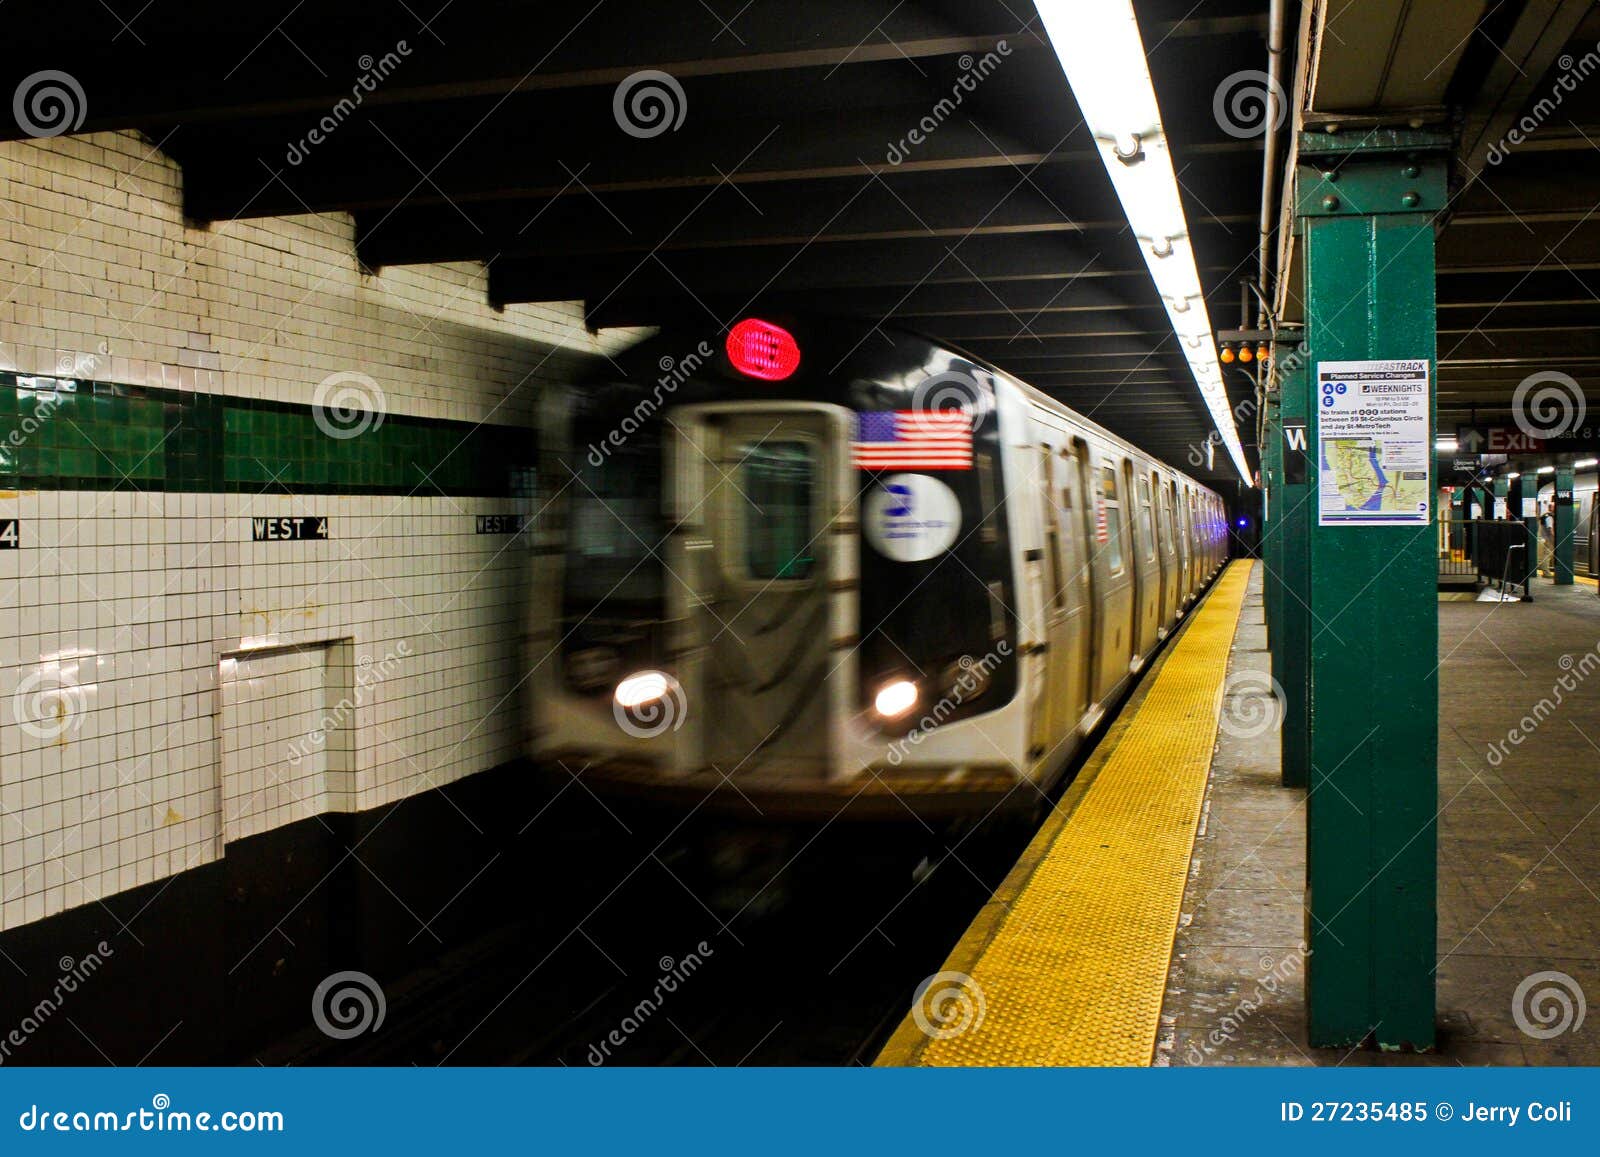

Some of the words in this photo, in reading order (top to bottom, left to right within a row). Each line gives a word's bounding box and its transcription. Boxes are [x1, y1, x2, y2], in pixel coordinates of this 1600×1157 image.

[1378, 362, 1424, 371] FASTRACK
[1371, 384, 1422, 393] WEEKNIGHTS
[1487, 428, 1538, 450] Exit
[1582, 428, 1592, 439] 8
[0, 520, 18, 547] 4
[253, 518, 304, 540] WEST
[316, 517, 328, 538] 4
[477, 516, 508, 533] WEST
